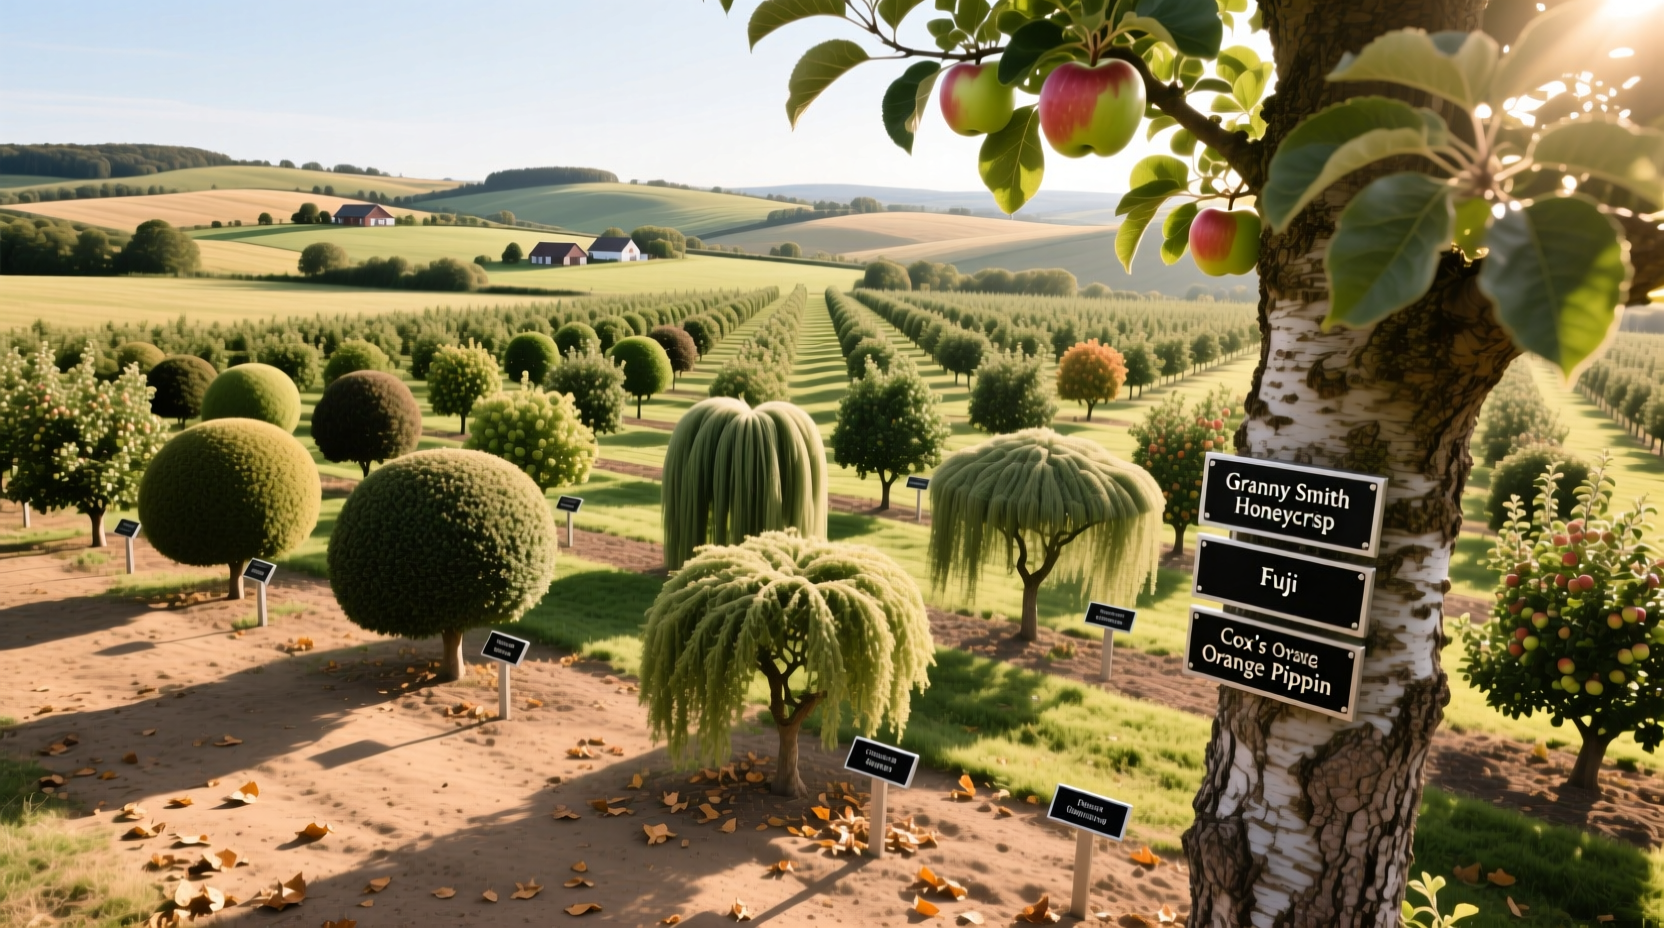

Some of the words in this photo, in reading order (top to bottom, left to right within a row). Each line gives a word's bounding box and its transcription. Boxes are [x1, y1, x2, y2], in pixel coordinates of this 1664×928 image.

[1226, 473, 1291, 502] Granny
[1295, 484, 1350, 509] Smith
[1260, 567, 1298, 597] Fuji
[1221, 627, 1267, 654] Cox's
[1202, 644, 1265, 679] Orange
[1271, 663, 1331, 696] Pippin
